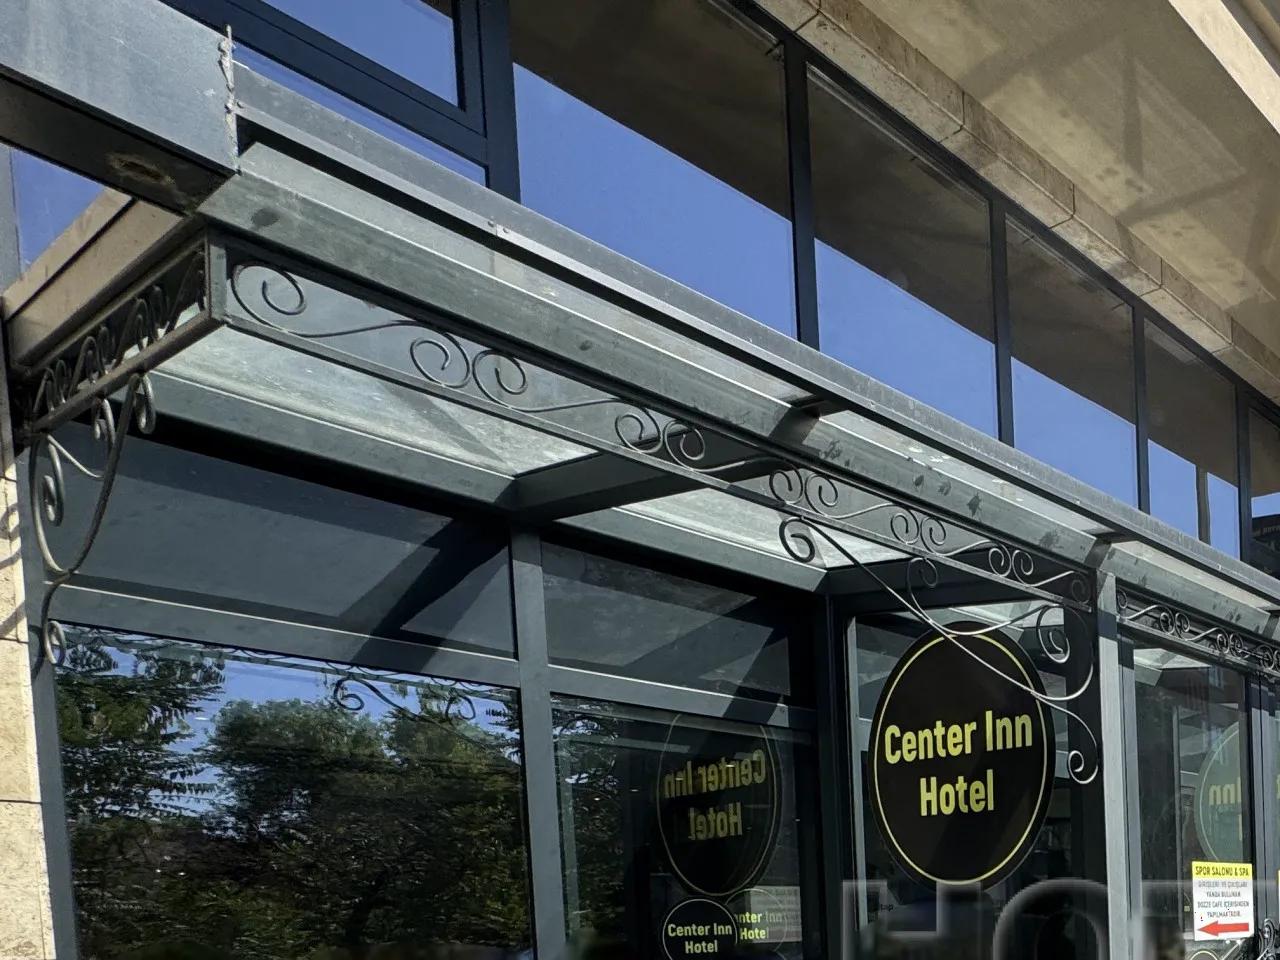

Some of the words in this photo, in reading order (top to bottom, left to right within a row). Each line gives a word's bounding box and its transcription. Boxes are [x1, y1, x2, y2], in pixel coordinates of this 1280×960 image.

[884, 720, 977, 764] Center
[985, 710, 1033, 752] Inn
[920, 769, 995, 816] Hotel
[1195, 865, 1210, 876] SPOR
[1212, 866, 1233, 876] SALONU
[1239, 867, 1249, 877] SPA
[667, 923, 711, 937] Center
[713, 923, 733, 935] Inn
[740, 926, 770, 940] Hotel
[685, 940, 718, 954] Hotel
